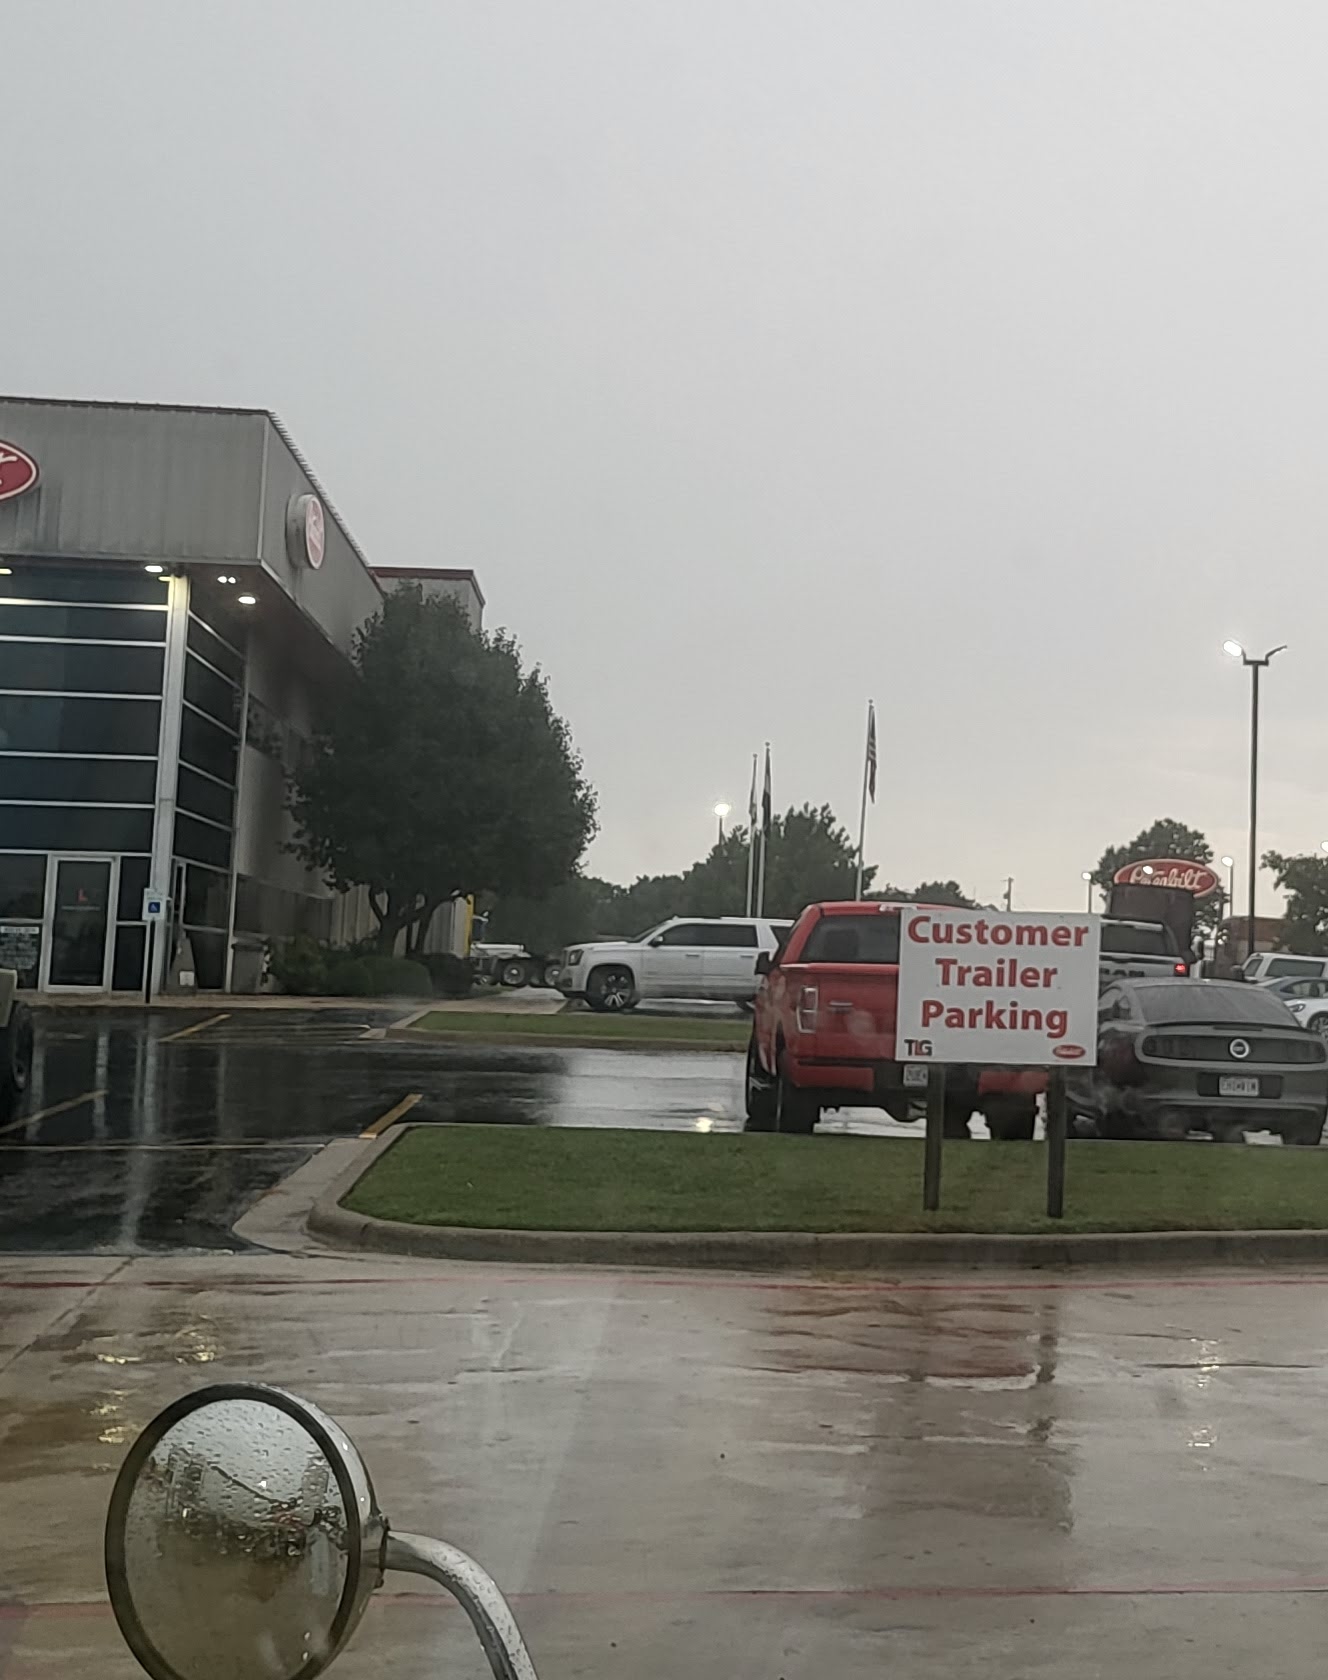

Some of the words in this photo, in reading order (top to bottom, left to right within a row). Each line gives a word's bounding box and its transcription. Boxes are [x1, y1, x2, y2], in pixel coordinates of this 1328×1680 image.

[908, 916, 1089, 946] Customer
[935, 958, 1058, 987] Trailer
[921, 1000, 1068, 1038] Parking
[904, 1039, 932, 1056] TLG
